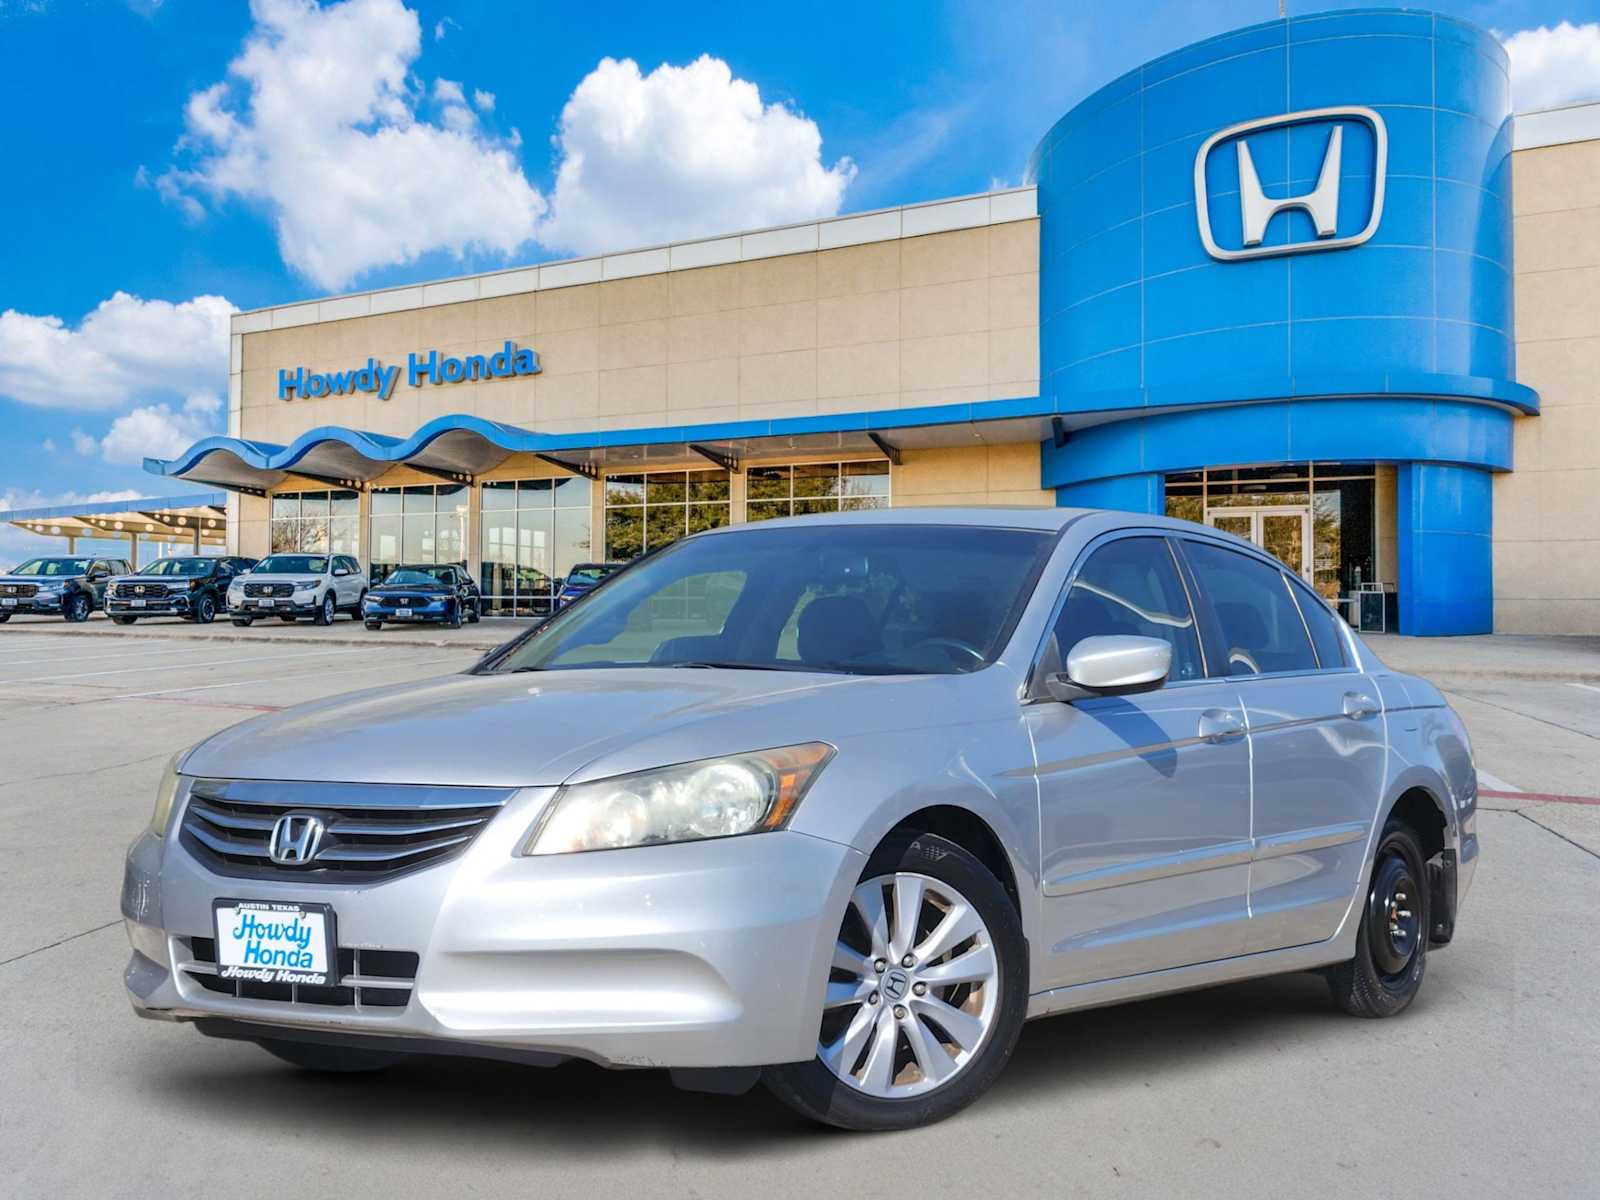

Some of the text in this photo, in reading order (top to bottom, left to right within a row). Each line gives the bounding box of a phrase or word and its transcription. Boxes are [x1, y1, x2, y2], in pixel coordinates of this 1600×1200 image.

[278, 340, 542, 401] Howdy Honda
[238, 902, 300, 912] AUSTIN TEXAS
[232, 913, 312, 949] Howdy
[244, 940, 313, 968] Honda
[221, 966, 327, 985] Howdy Honda
